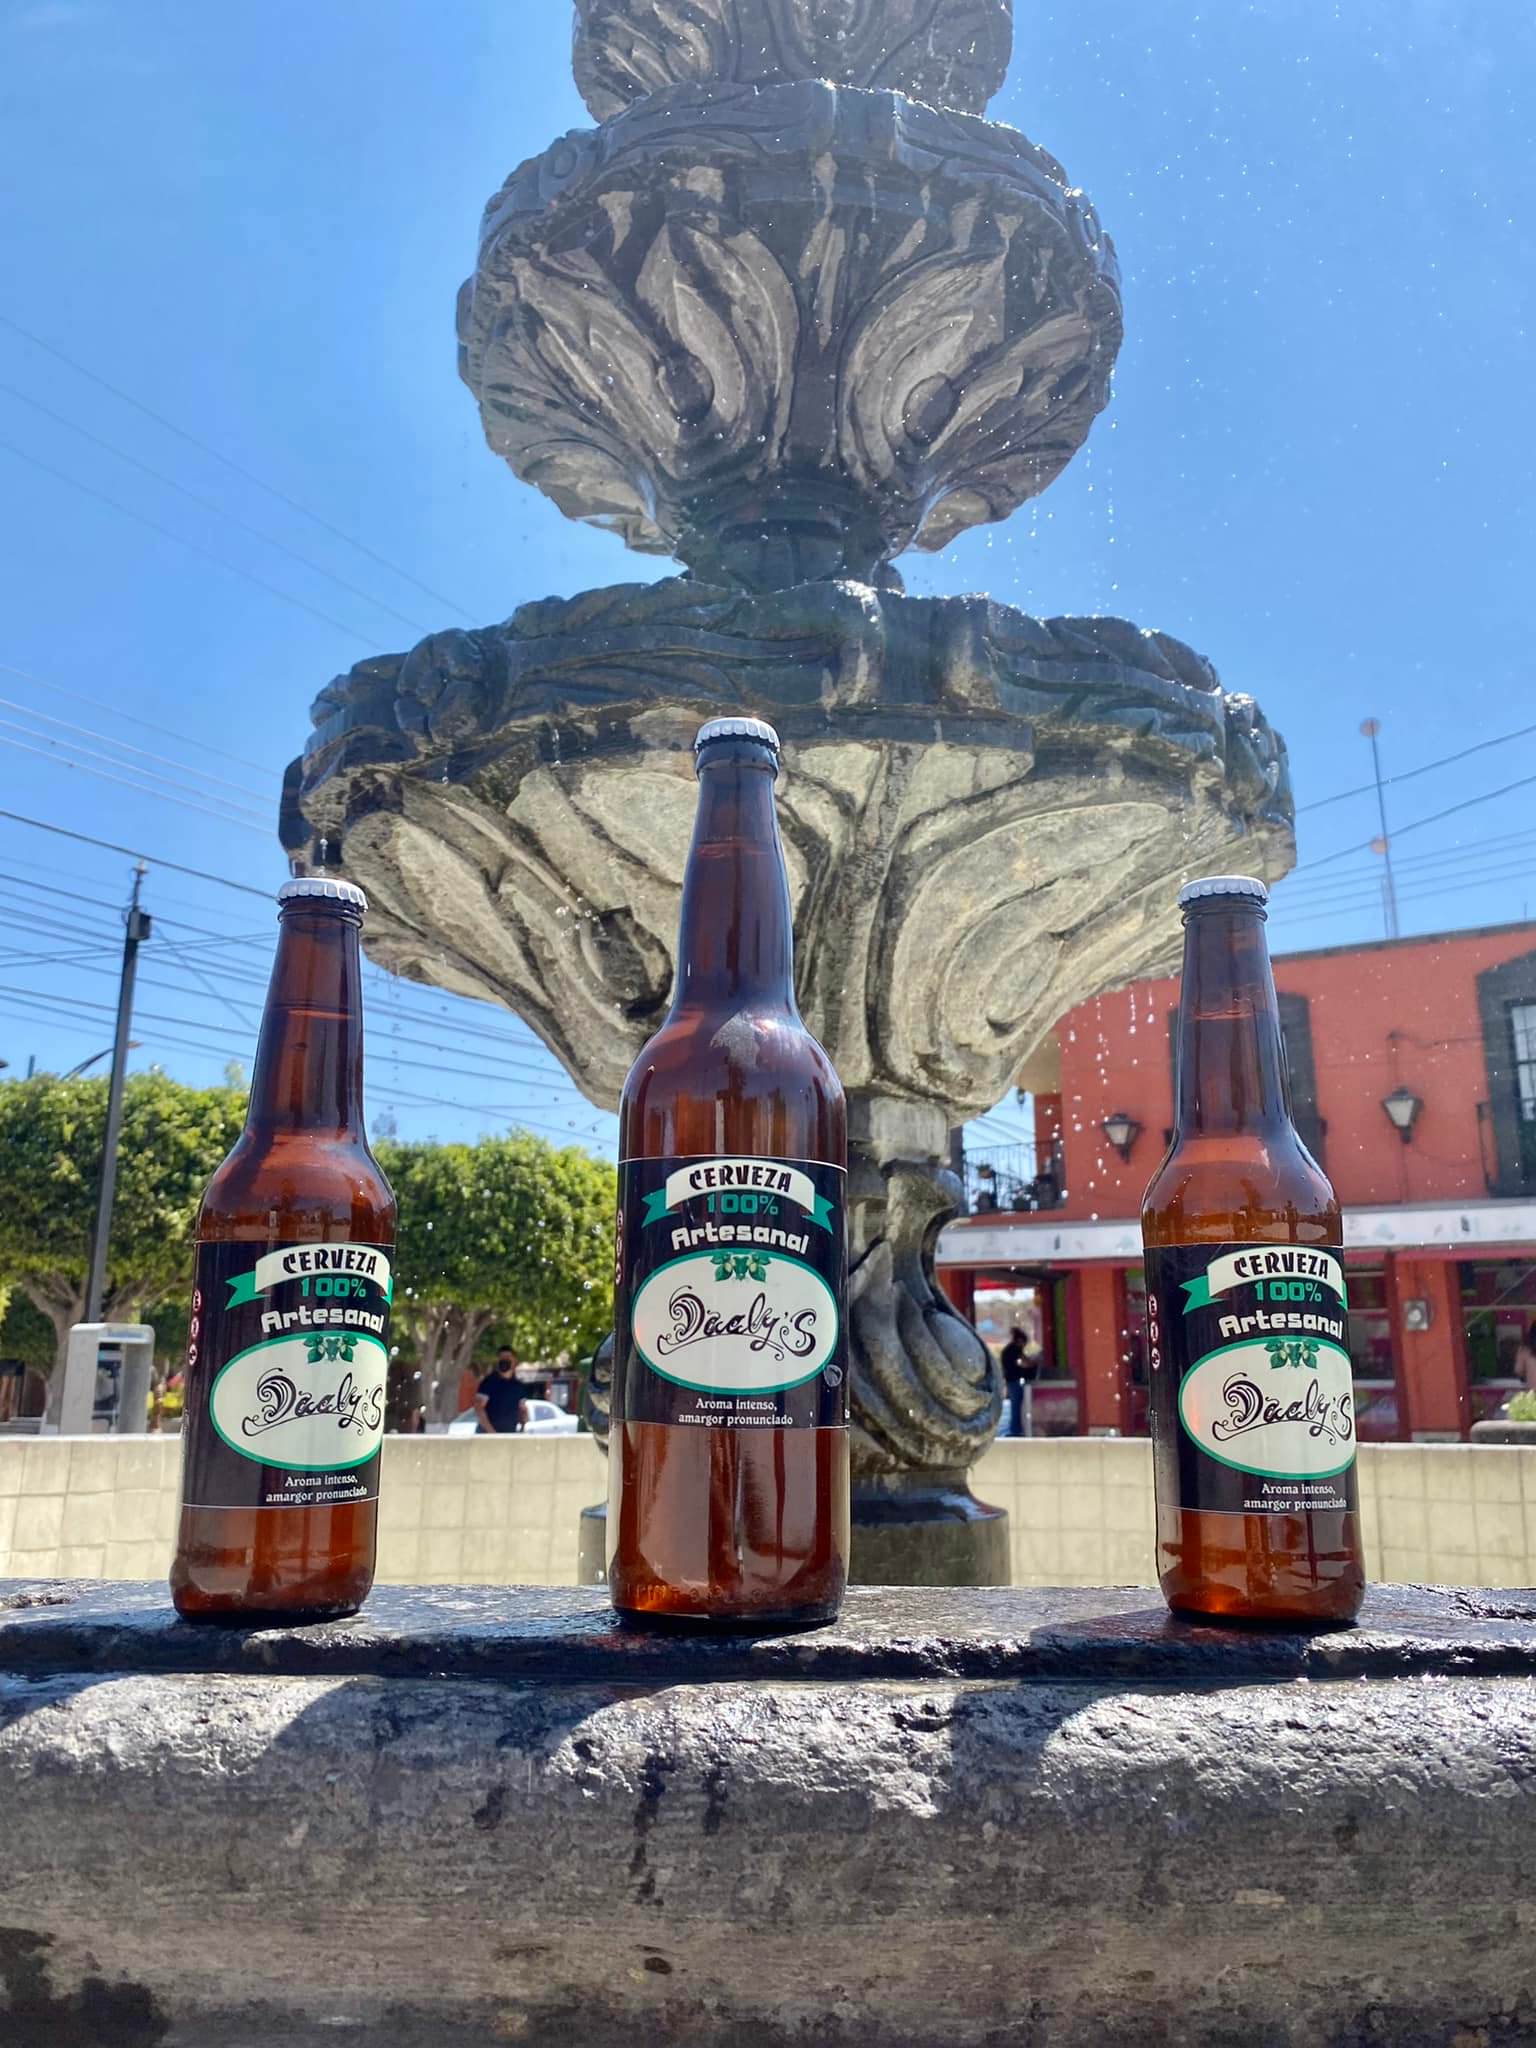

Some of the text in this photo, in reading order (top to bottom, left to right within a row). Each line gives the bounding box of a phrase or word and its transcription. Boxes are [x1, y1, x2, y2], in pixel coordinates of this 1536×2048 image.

[689, 1164, 792, 1193] CERVEZA
[706, 1193, 779, 1215] 100%
[671, 1222, 809, 1254] Artesanal
[282, 1248, 377, 1276] CERVEZA
[1233, 1251, 1329, 1279] CERVEZA
[301, 1278, 367, 1298] 100%
[1254, 1281, 1322, 1302] 100%
[261, 1305, 385, 1334] Artesanal
[1218, 1309, 1343, 1340] Artesanal
[696, 1398, 732, 1410] Aroma
[678, 1414, 793, 1427] amargor pronunciado
[285, 1476, 322, 1487] Aroma
[1261, 1483, 1298, 1494] Aroma
[266, 1486, 367, 1503] amargor pronunciado
[1243, 1499, 1292, 1512] amargor
